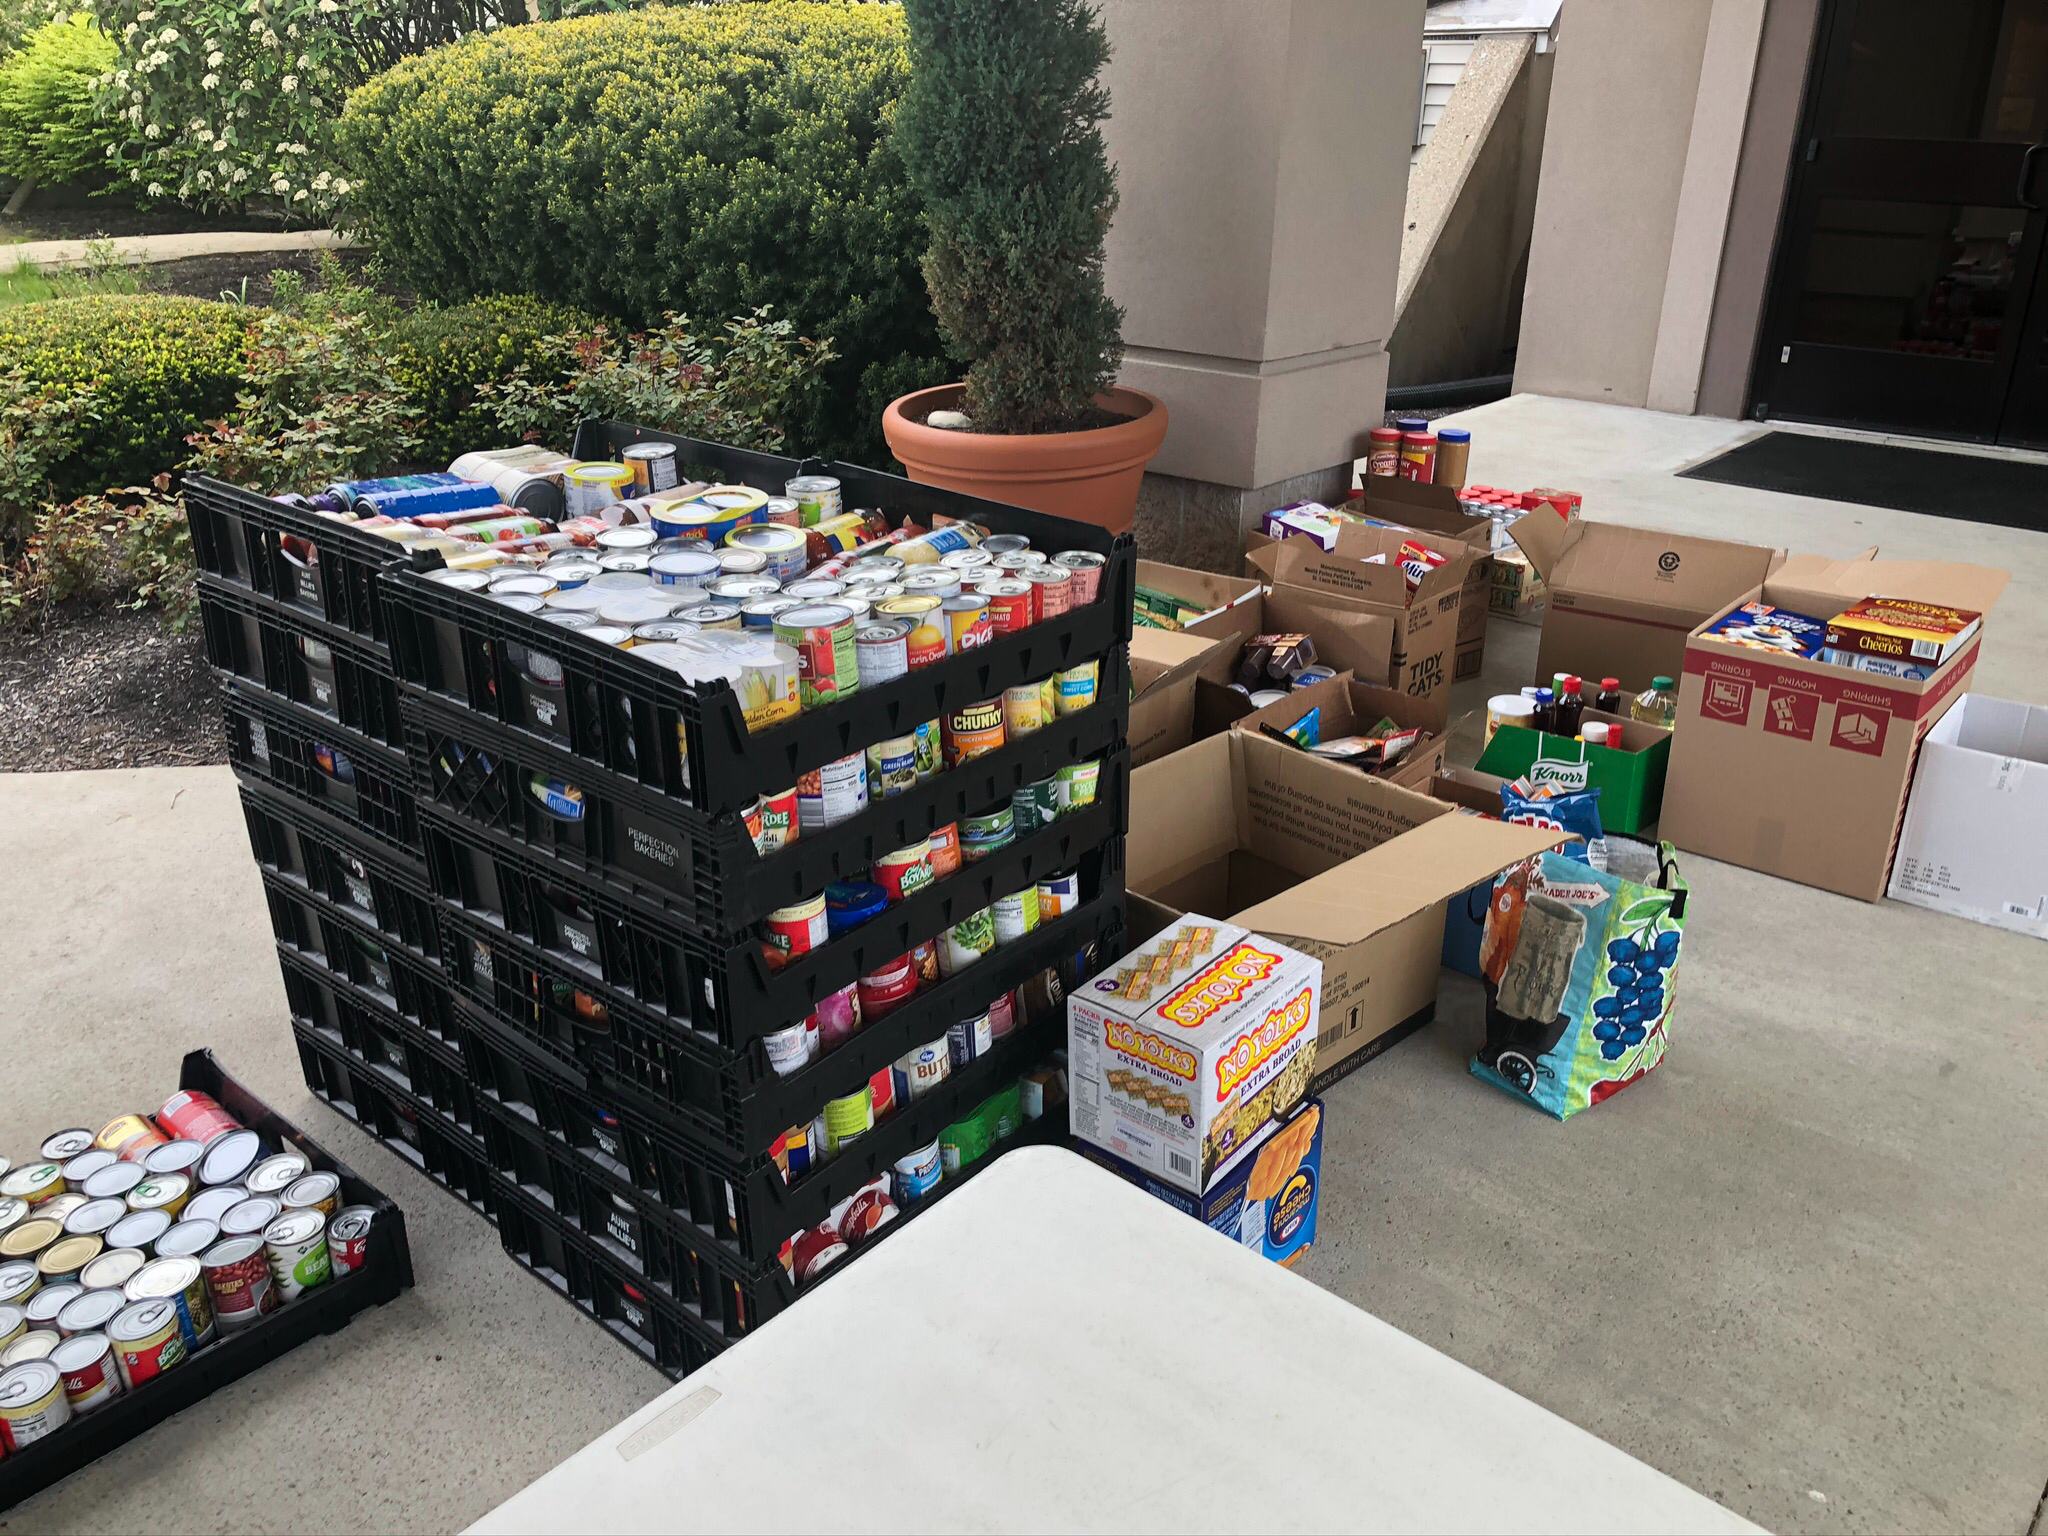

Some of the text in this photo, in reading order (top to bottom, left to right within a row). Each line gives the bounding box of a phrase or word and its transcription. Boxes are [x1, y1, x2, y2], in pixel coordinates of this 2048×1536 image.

[1859, 635, 1903, 656] Cheerios
[1410, 651, 1443, 680] TIDY
[1711, 661, 1751, 677] STORING
[1407, 669, 1444, 697] CATS
[1777, 676, 1817, 690] MOVING
[1842, 689, 1892, 706] SHIPPING
[953, 708, 1002, 731] CHUNKY
[883, 761, 901, 771] GREEN
[1533, 766, 1584, 784] Knorr
[1264, 779, 1393, 835] polyfoam before disposing of the
[1293, 804, 1304, 814] all
[1347, 797, 1386, 817] materials
[1285, 816, 1306, 829] white
[1304, 809, 1335, 826] remove
[1335, 821, 1351, 832] you
[628, 827, 679, 858] PERFECTION
[1280, 826, 1326, 849] accessories
[1307, 825, 1335, 841] bottom
[1335, 835, 1352, 847] and
[1352, 829, 1371, 842] sure
[633, 841, 674, 867] BAKERIES
[1327, 844, 1341, 857] are
[1571, 889, 1595, 900] JOE'S
[1174, 973, 1244, 1022] YOLKS
[1078, 1007, 1101, 1020] PACKS
[1111, 1025, 1192, 1071] NO YOLKS
[1223, 1043, 1250, 1083] NO
[1252, 997, 1307, 1057] YOLKS
[917, 1051, 949, 1078] BUTT
[1117, 1052, 1182, 1087] EXTRA BROAD
[1241, 1038, 1301, 1098] EXTRA BROAD
[1313, 1040, 1382, 1090] ANDLE WITH CARE
[1225, 1130, 1230, 1141] 4
[611, 1212, 630, 1233] AUNT
